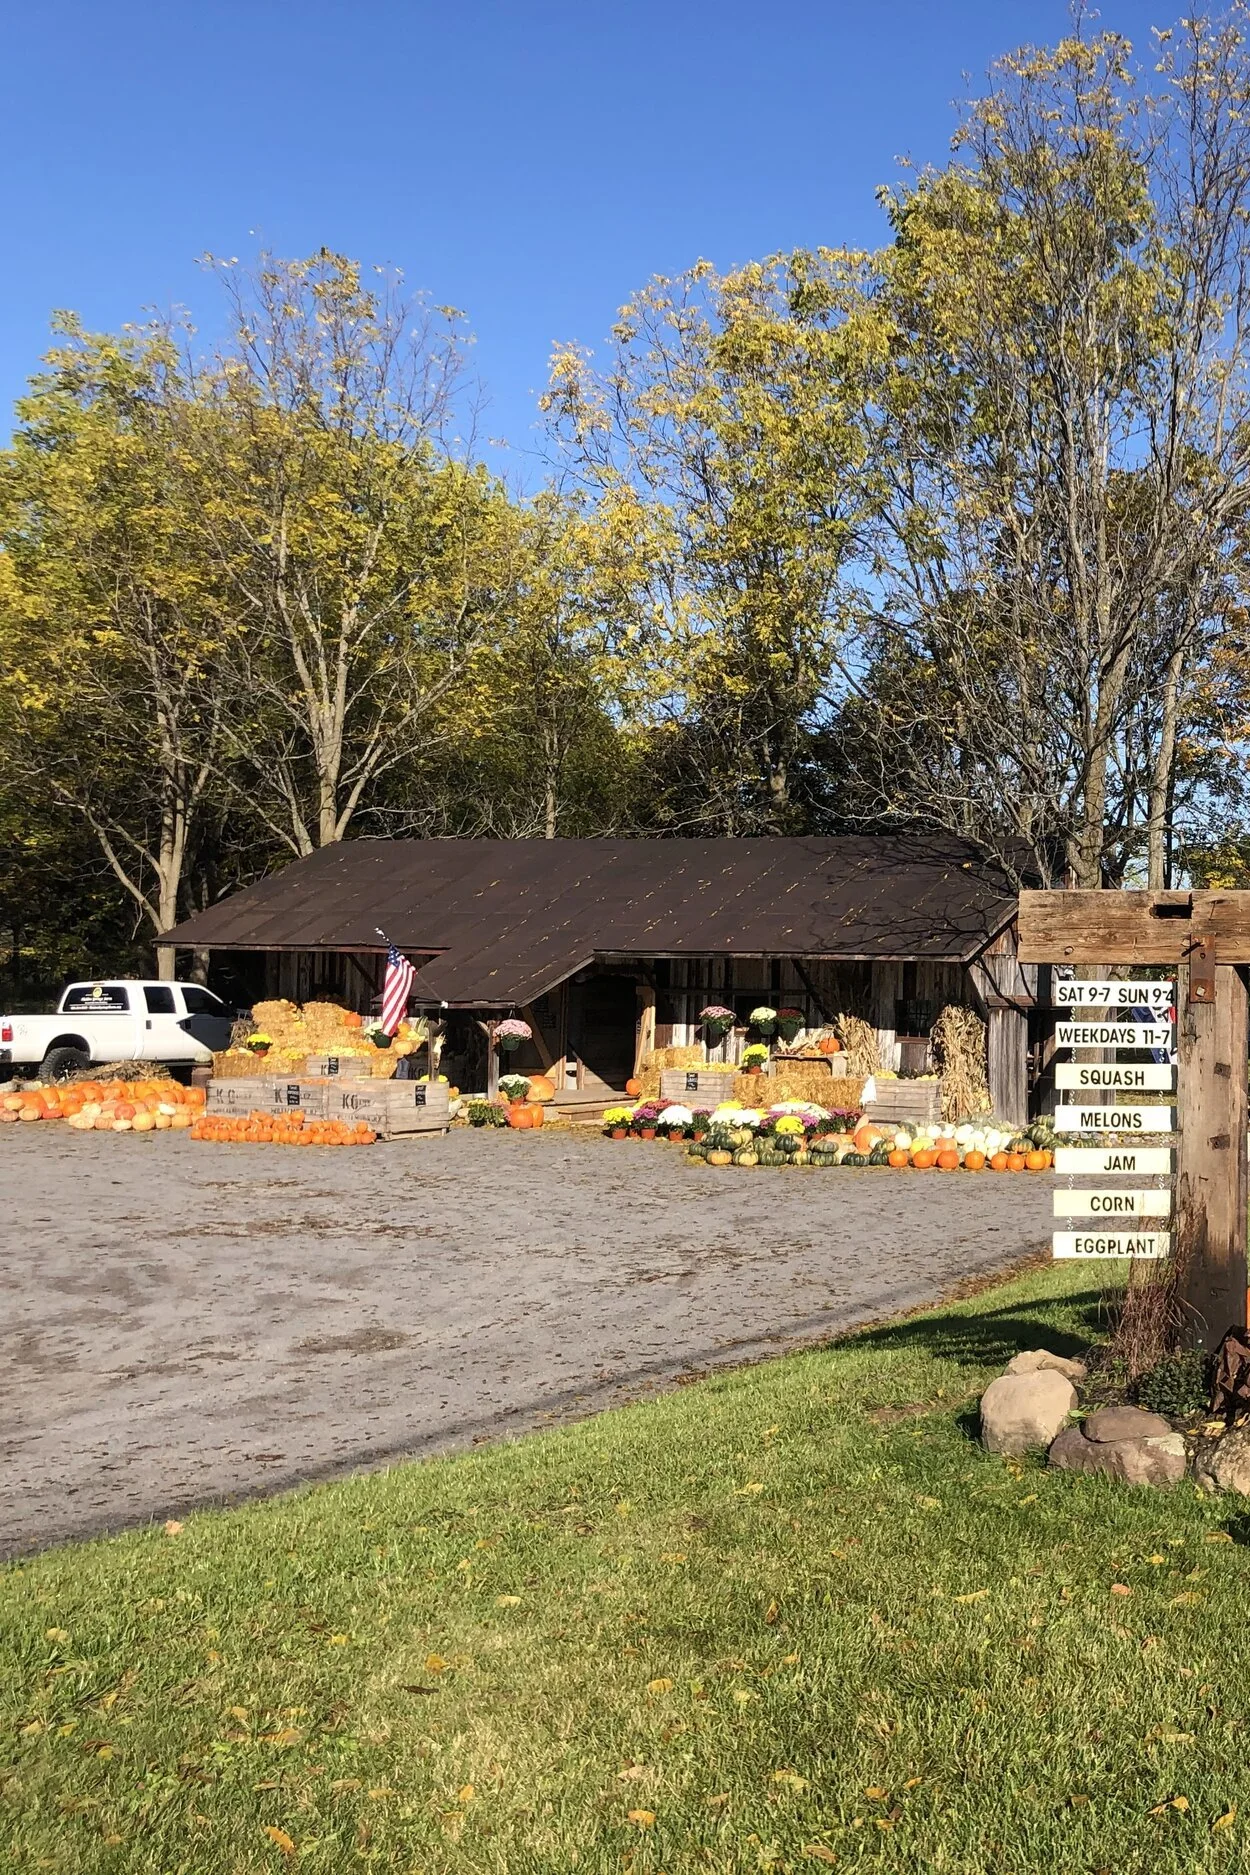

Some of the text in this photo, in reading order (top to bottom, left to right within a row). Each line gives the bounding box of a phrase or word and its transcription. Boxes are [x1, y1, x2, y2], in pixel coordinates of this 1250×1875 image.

[1058, 986, 1175, 1004] SAT 9-7 SUN 9-4
[1058, 1028, 1170, 1045] WEEKDAYS 11-7
[1079, 1069, 1145, 1086] SQUASH
[1080, 1112, 1143, 1129] MELONS
[1103, 1156, 1136, 1171] JAM
[1090, 1196, 1135, 1212] CORN
[1075, 1238, 1156, 1255] EGGPLANT
